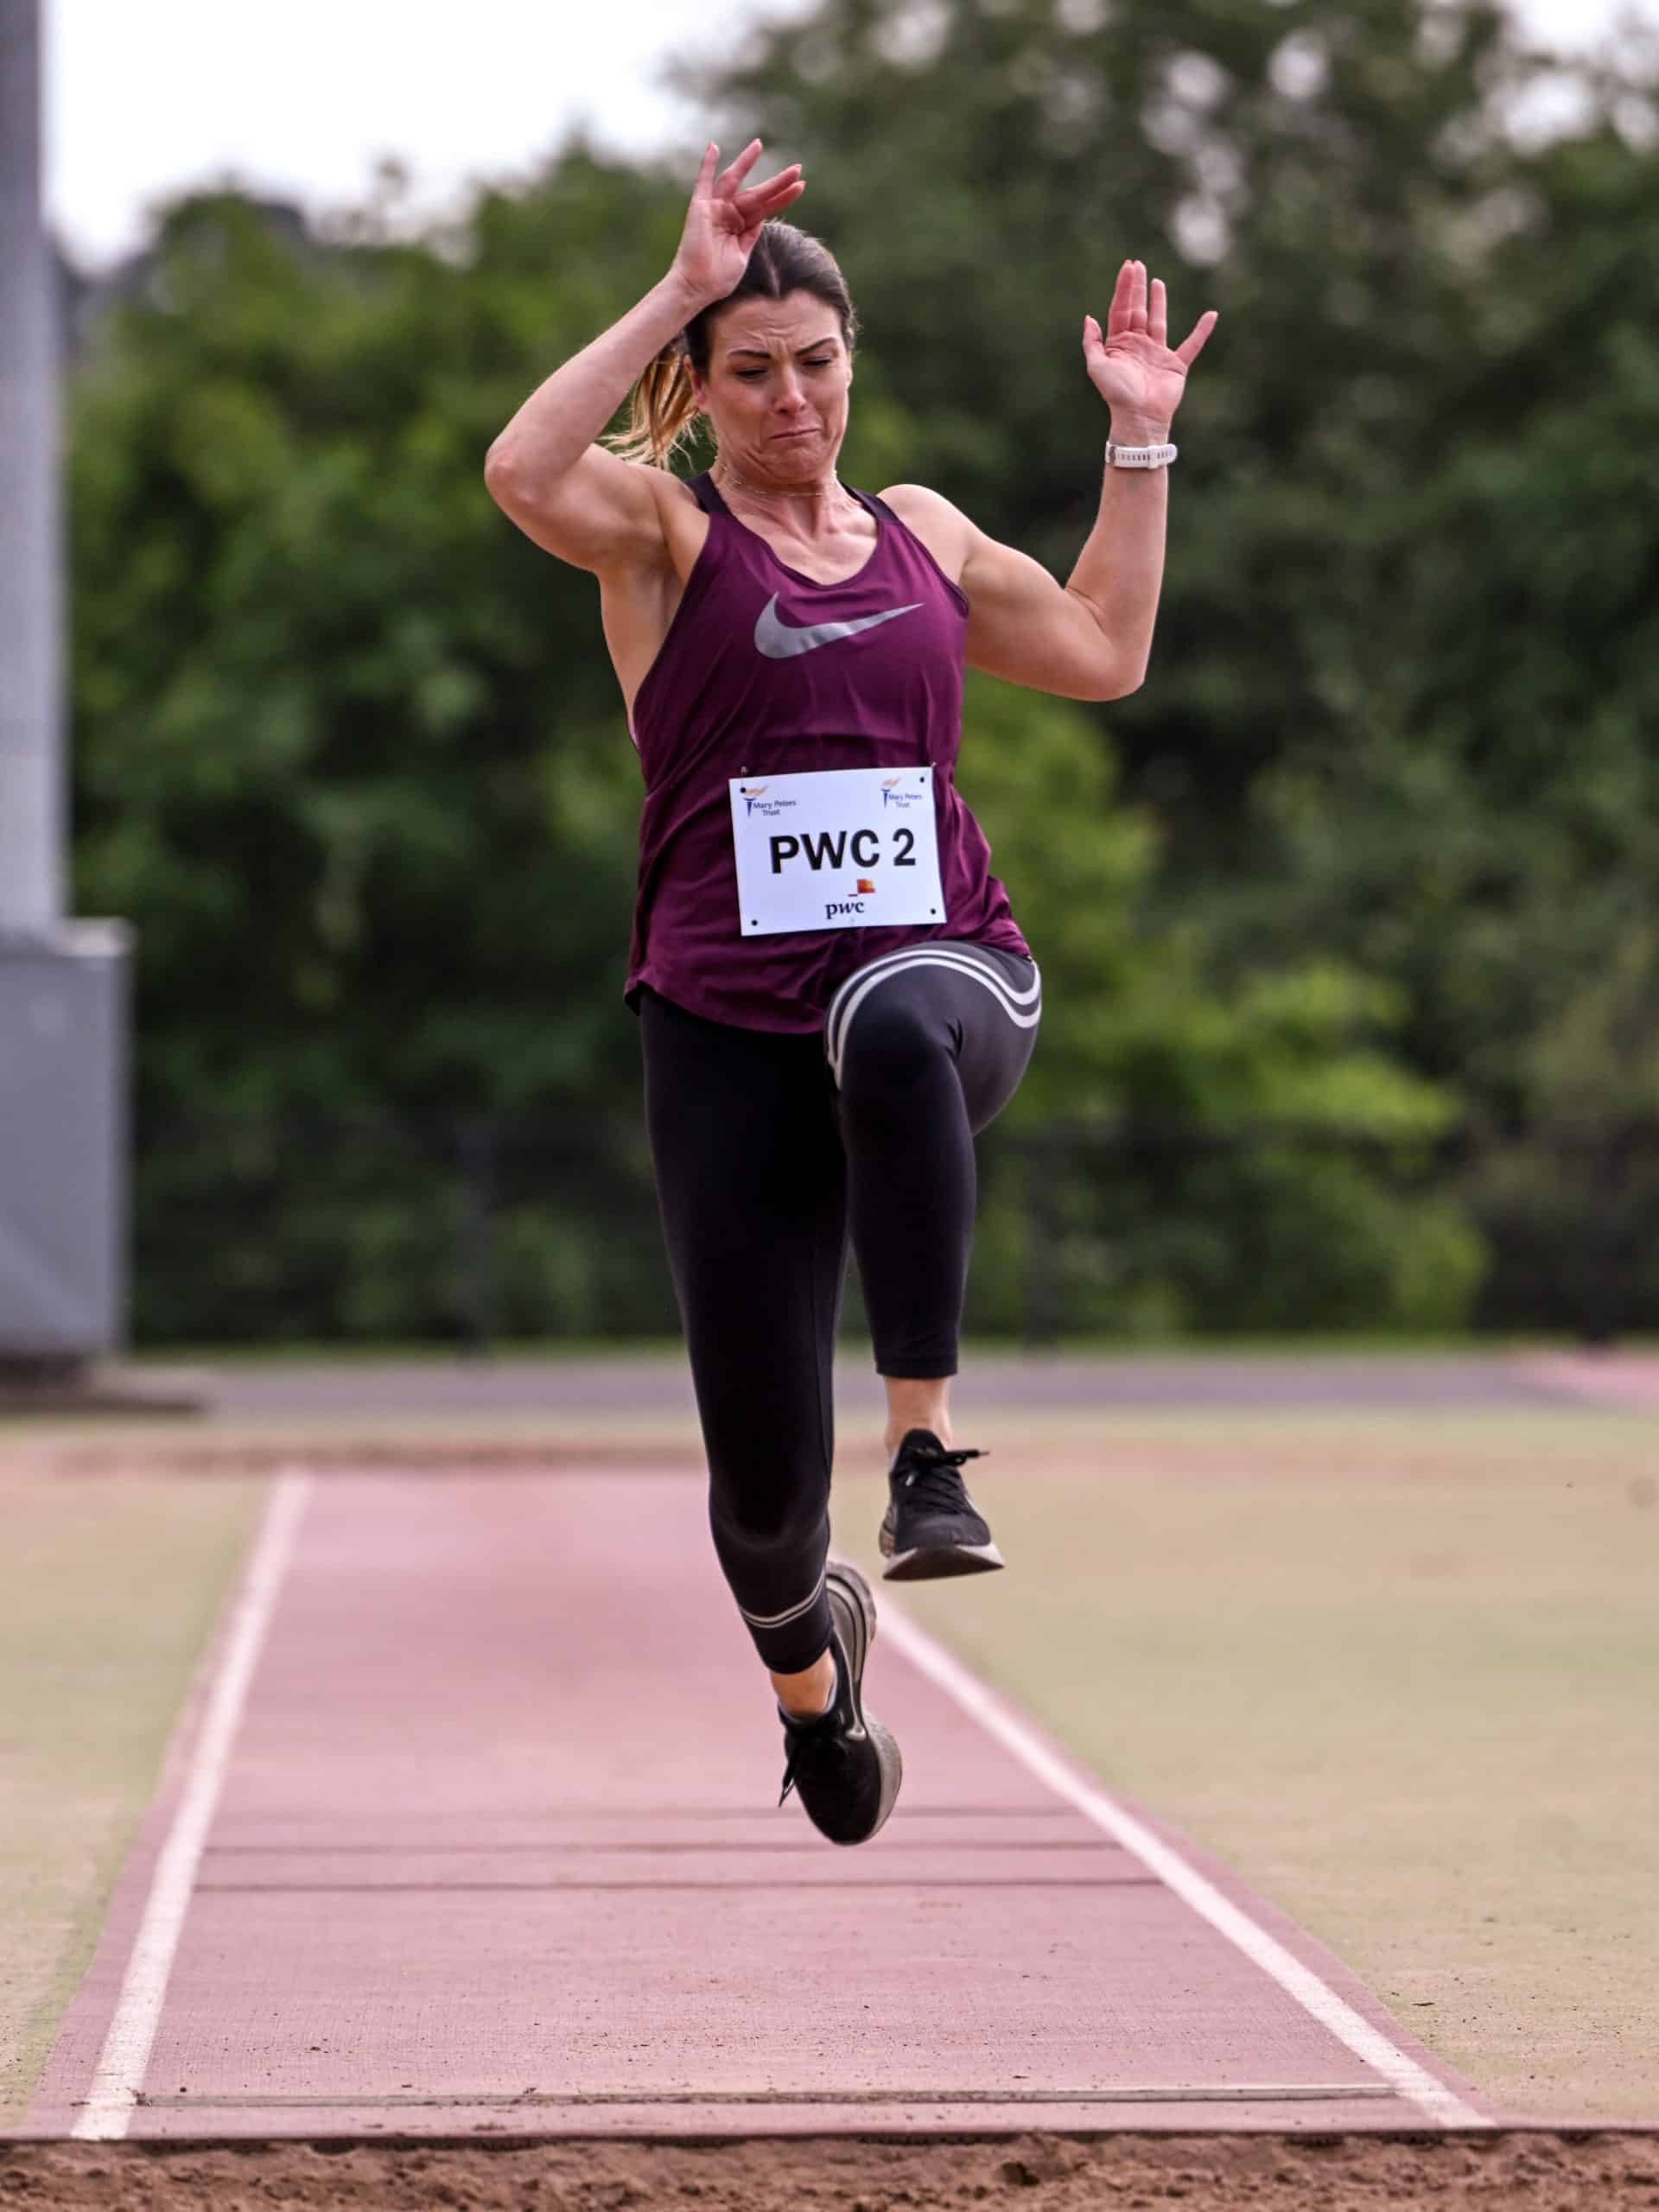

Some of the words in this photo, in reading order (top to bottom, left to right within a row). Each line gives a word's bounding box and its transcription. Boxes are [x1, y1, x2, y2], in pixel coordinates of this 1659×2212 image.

[769, 828, 880, 874] PWC
[892, 827, 917, 867] 2
[825, 901, 865, 920] pwc
